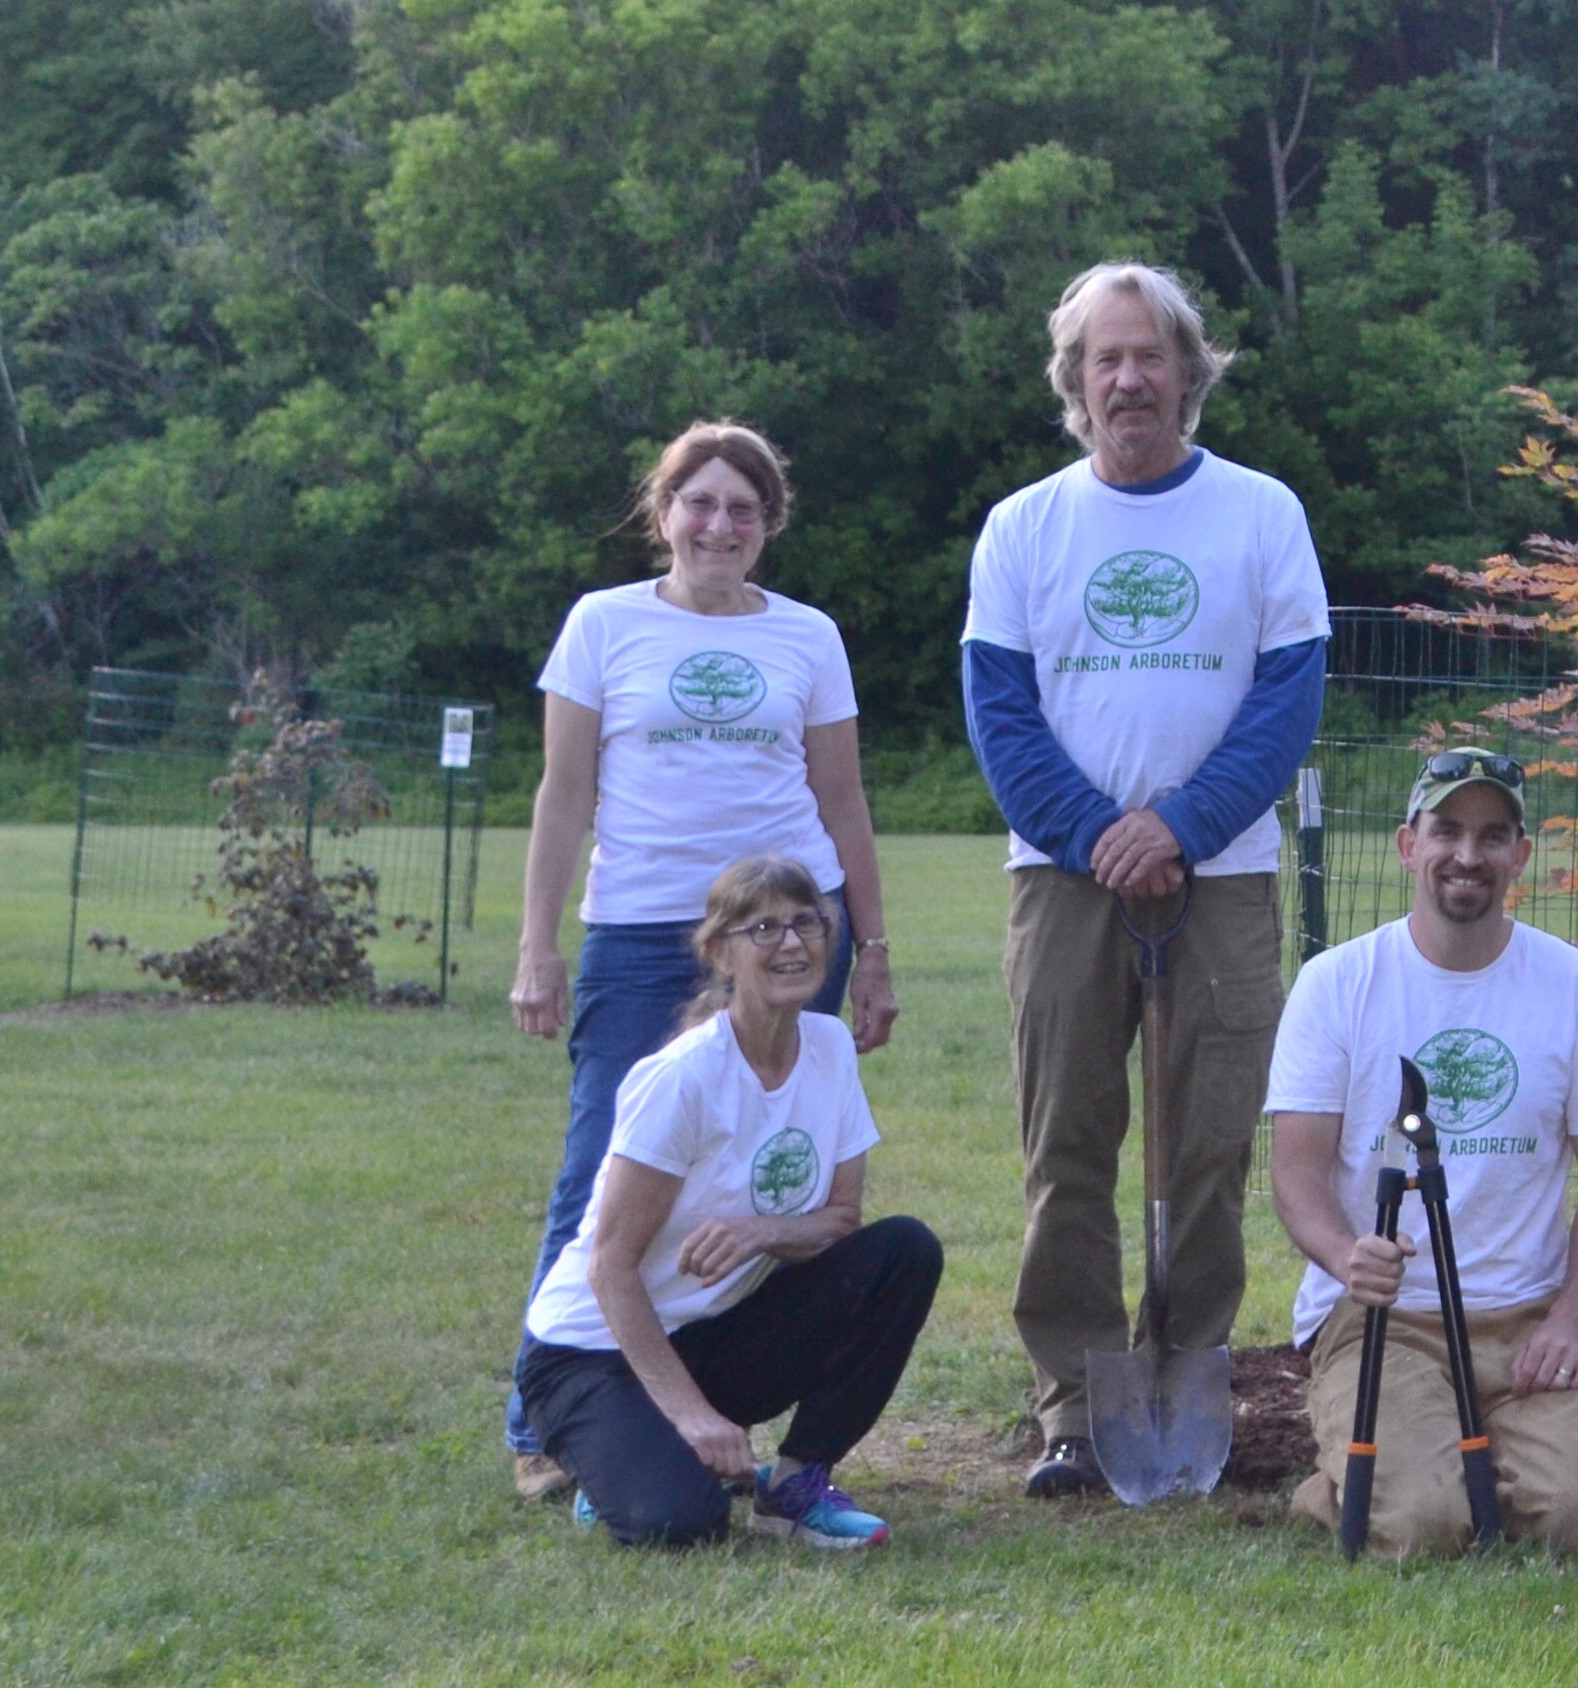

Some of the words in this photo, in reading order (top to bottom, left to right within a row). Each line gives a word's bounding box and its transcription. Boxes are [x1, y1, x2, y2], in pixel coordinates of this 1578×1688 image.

[1054, 654, 1121, 673] JOHNSON
[1129, 652, 1223, 671] ARBORETUM
[648, 727, 702, 744] JOHNSON
[1449, 1137, 1538, 1156] ARBORETUM
